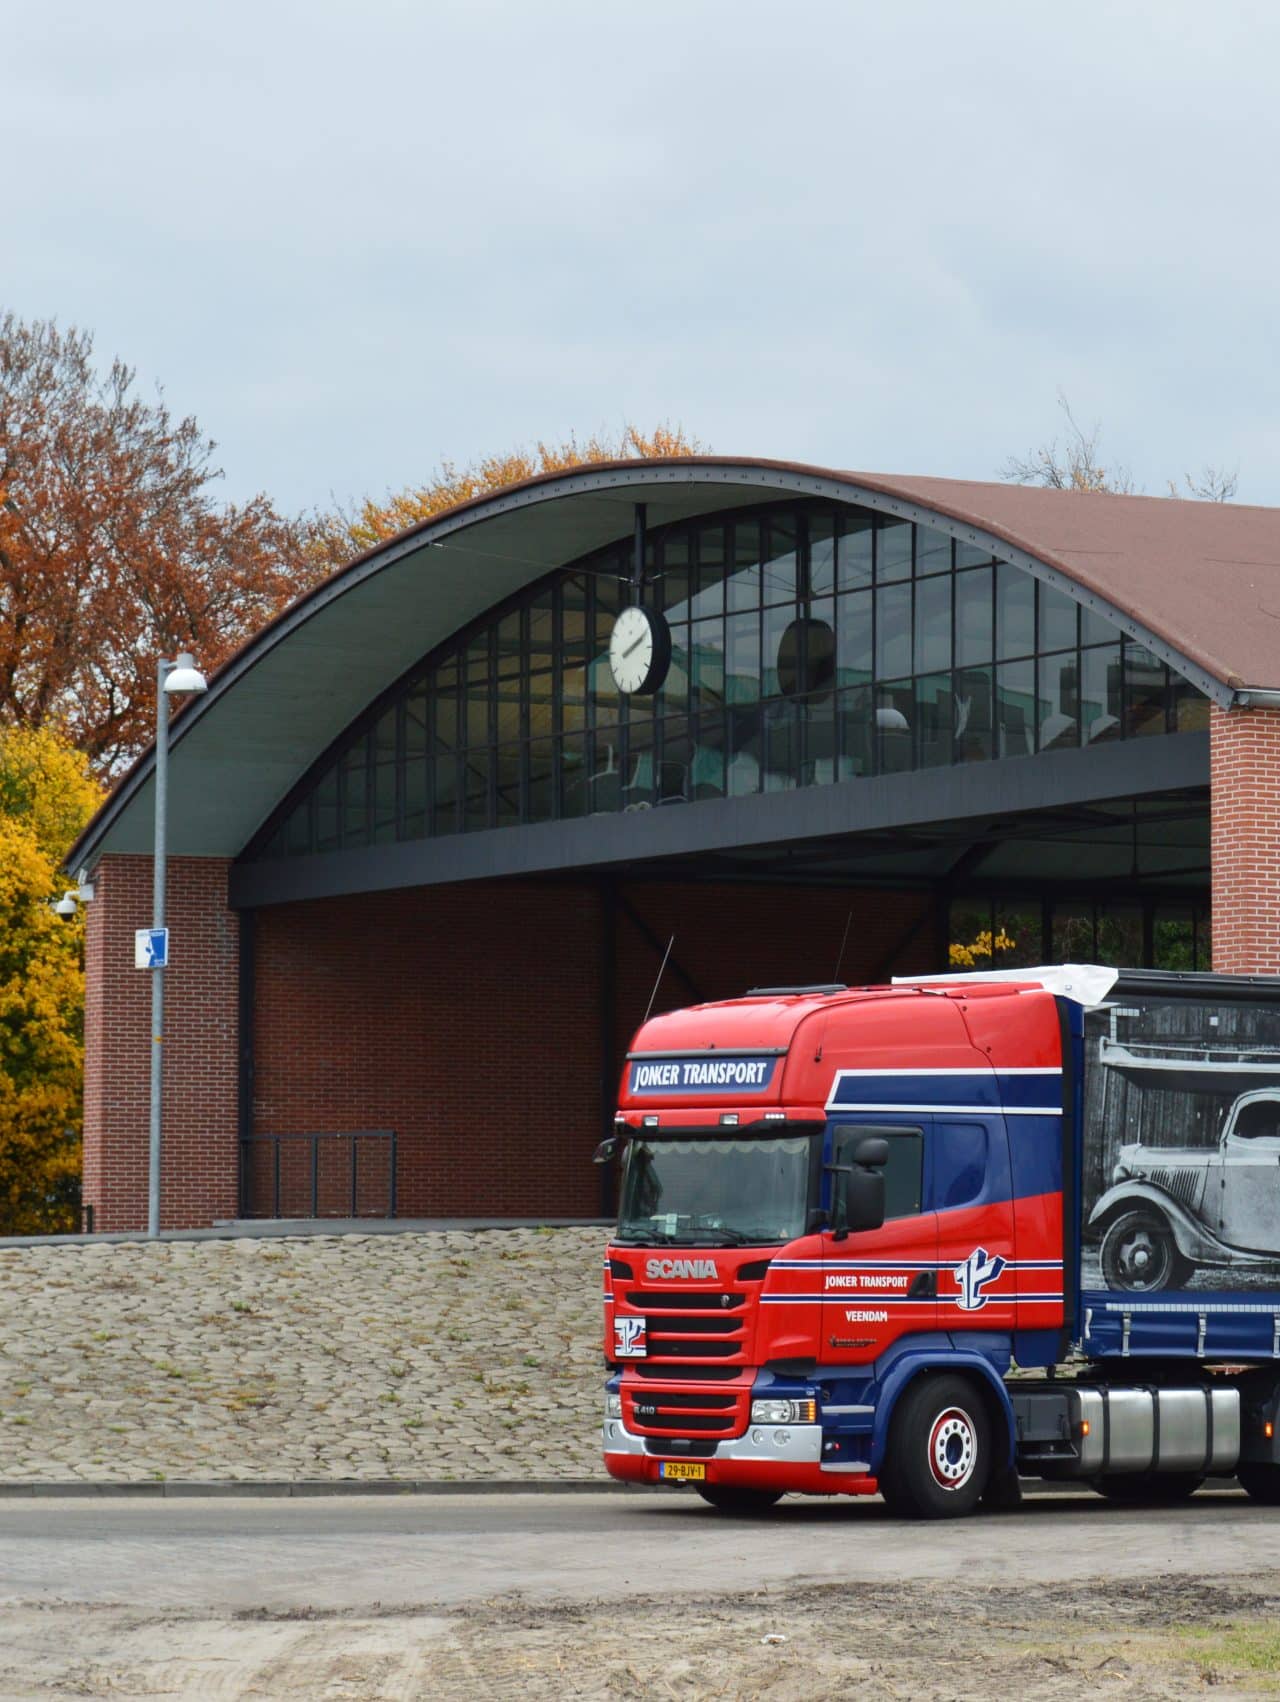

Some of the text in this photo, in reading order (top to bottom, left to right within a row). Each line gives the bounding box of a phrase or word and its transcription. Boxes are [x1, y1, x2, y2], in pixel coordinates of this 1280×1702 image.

[633, 1062, 767, 1092] JONKER TRANSPORT
[646, 1259, 718, 1279] SCANIA
[825, 1275, 908, 1290] JONKER TRANSPORT
[845, 1310, 888, 1322] VEENDAM
